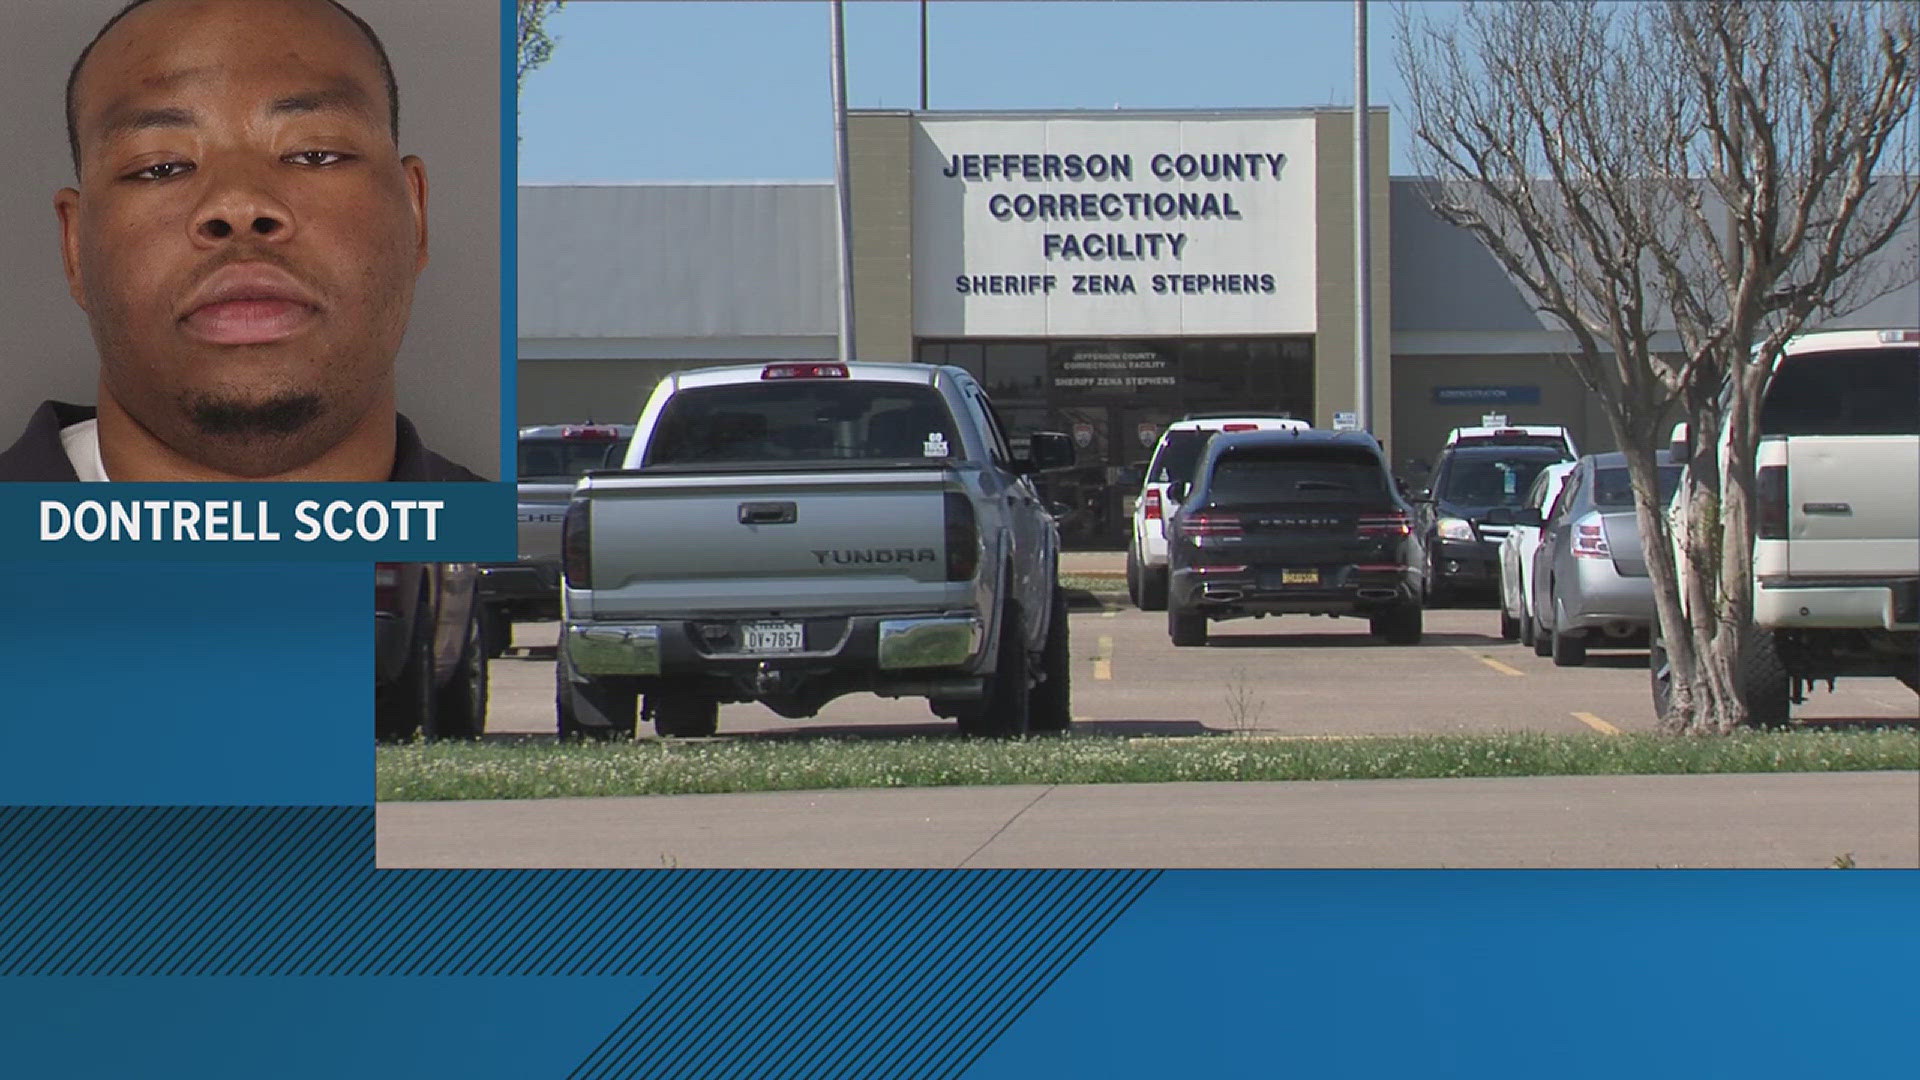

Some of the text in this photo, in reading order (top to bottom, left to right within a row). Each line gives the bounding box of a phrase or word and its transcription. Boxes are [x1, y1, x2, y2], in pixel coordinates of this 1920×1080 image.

[943, 153, 1287, 180] JEFFERSON COUNTY
[988, 193, 1242, 219] CORRECTIONAL
[1043, 232, 1186, 259] FACILITY
[956, 273, 1276, 295] SHERIFF ZENA STEPHENS
[1063, 361, 1166, 370] CORRECTIONAL FACILITY
[1072, 352, 1157, 361] JEFFERSON COUNTY
[1055, 376, 1176, 386] SHERIFF ZENA STEPHENS
[811, 548, 937, 565] TUNDRA
